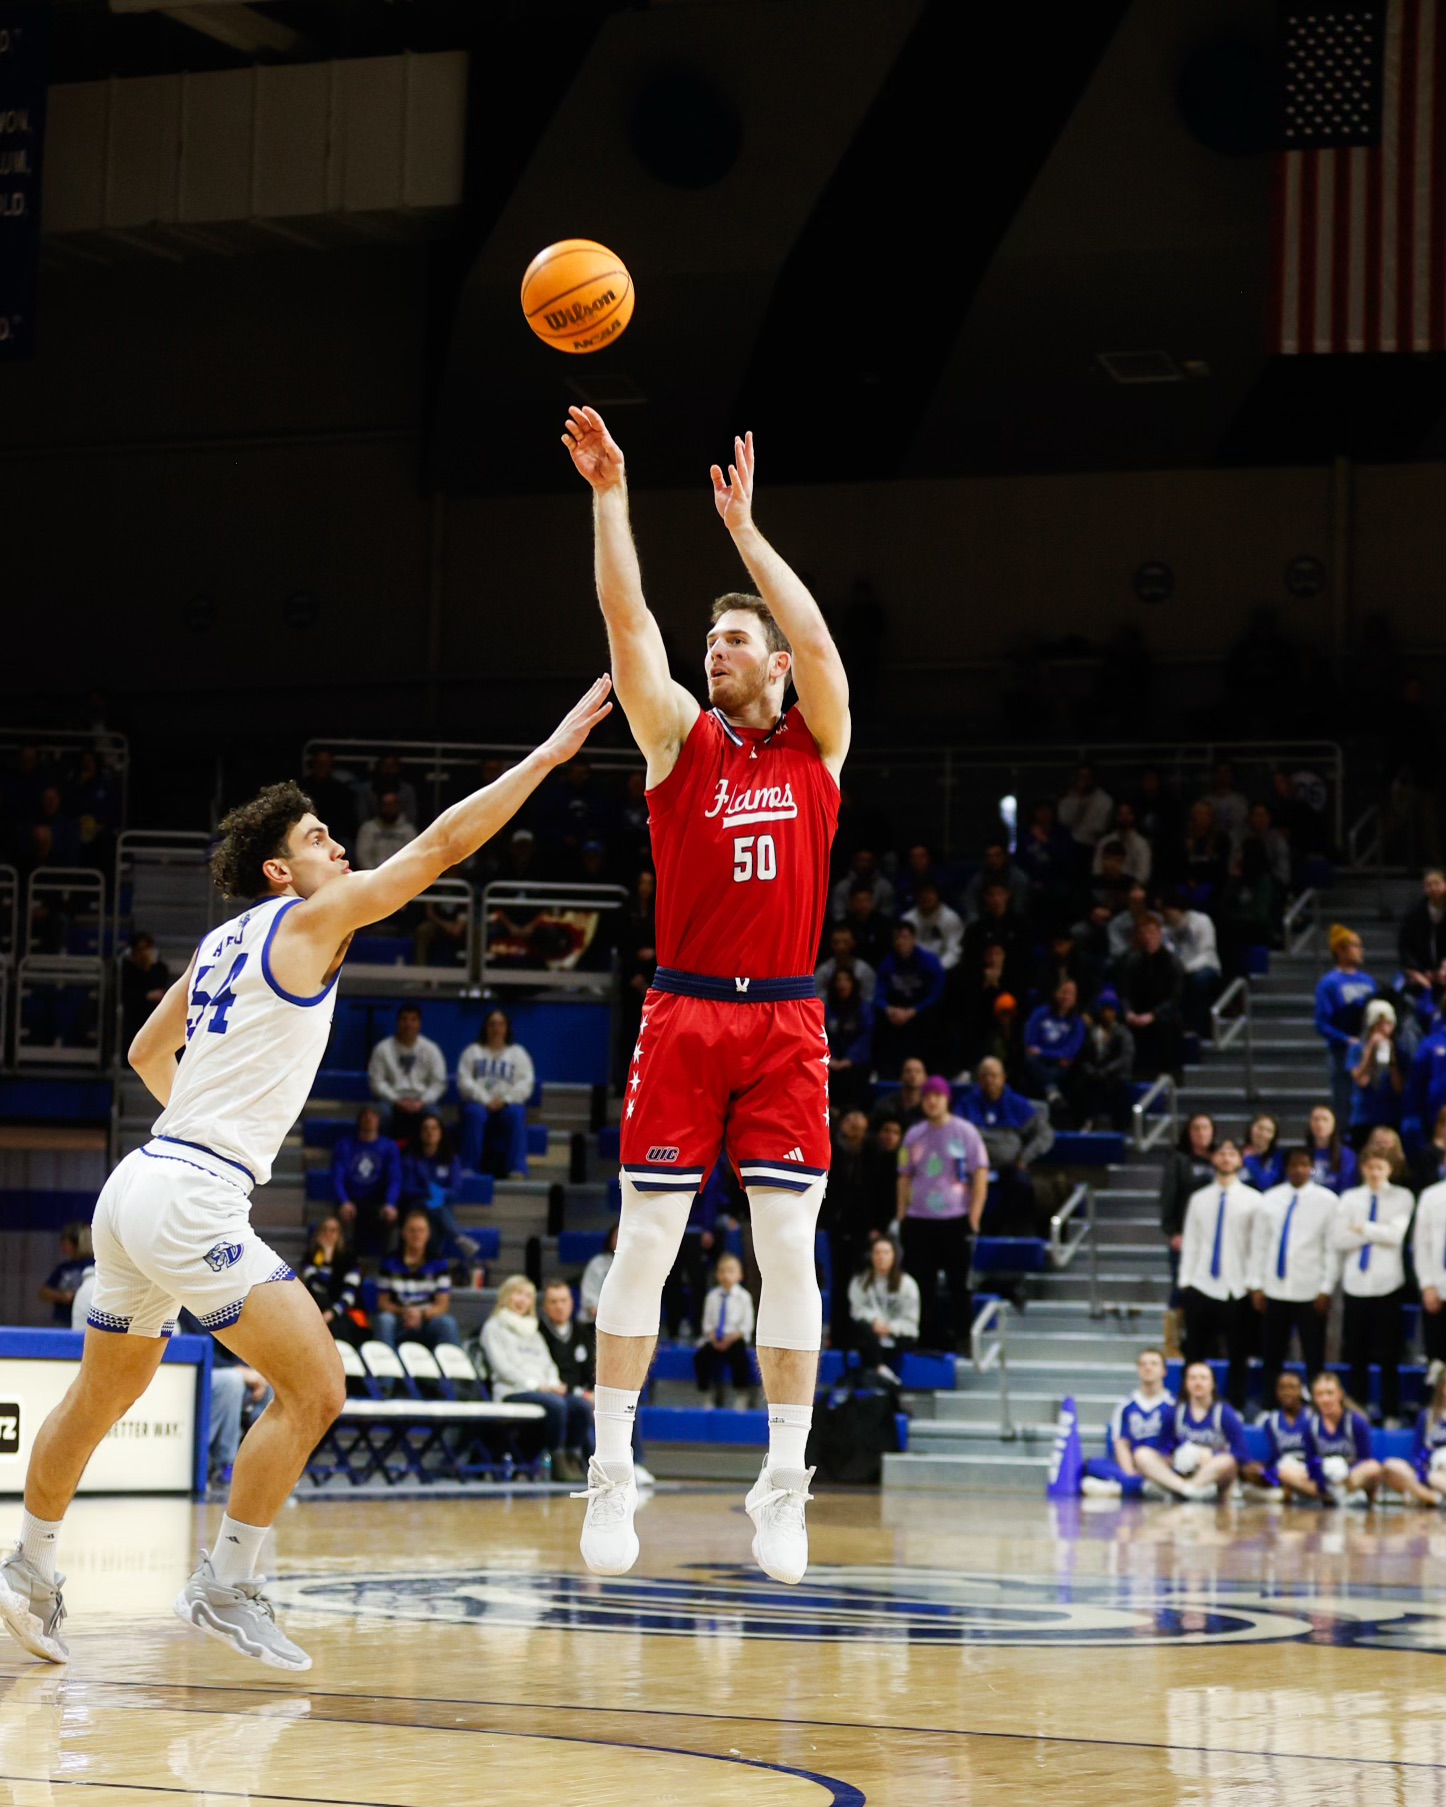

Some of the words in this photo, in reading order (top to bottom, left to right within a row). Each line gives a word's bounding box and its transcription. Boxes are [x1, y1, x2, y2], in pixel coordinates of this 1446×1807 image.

[544, 289, 617, 331] Wilson
[704, 778, 797, 824] Flames
[733, 834, 778, 883] 50
[186, 952, 249, 1042] 54
[647, 1147, 679, 1161] UIC
